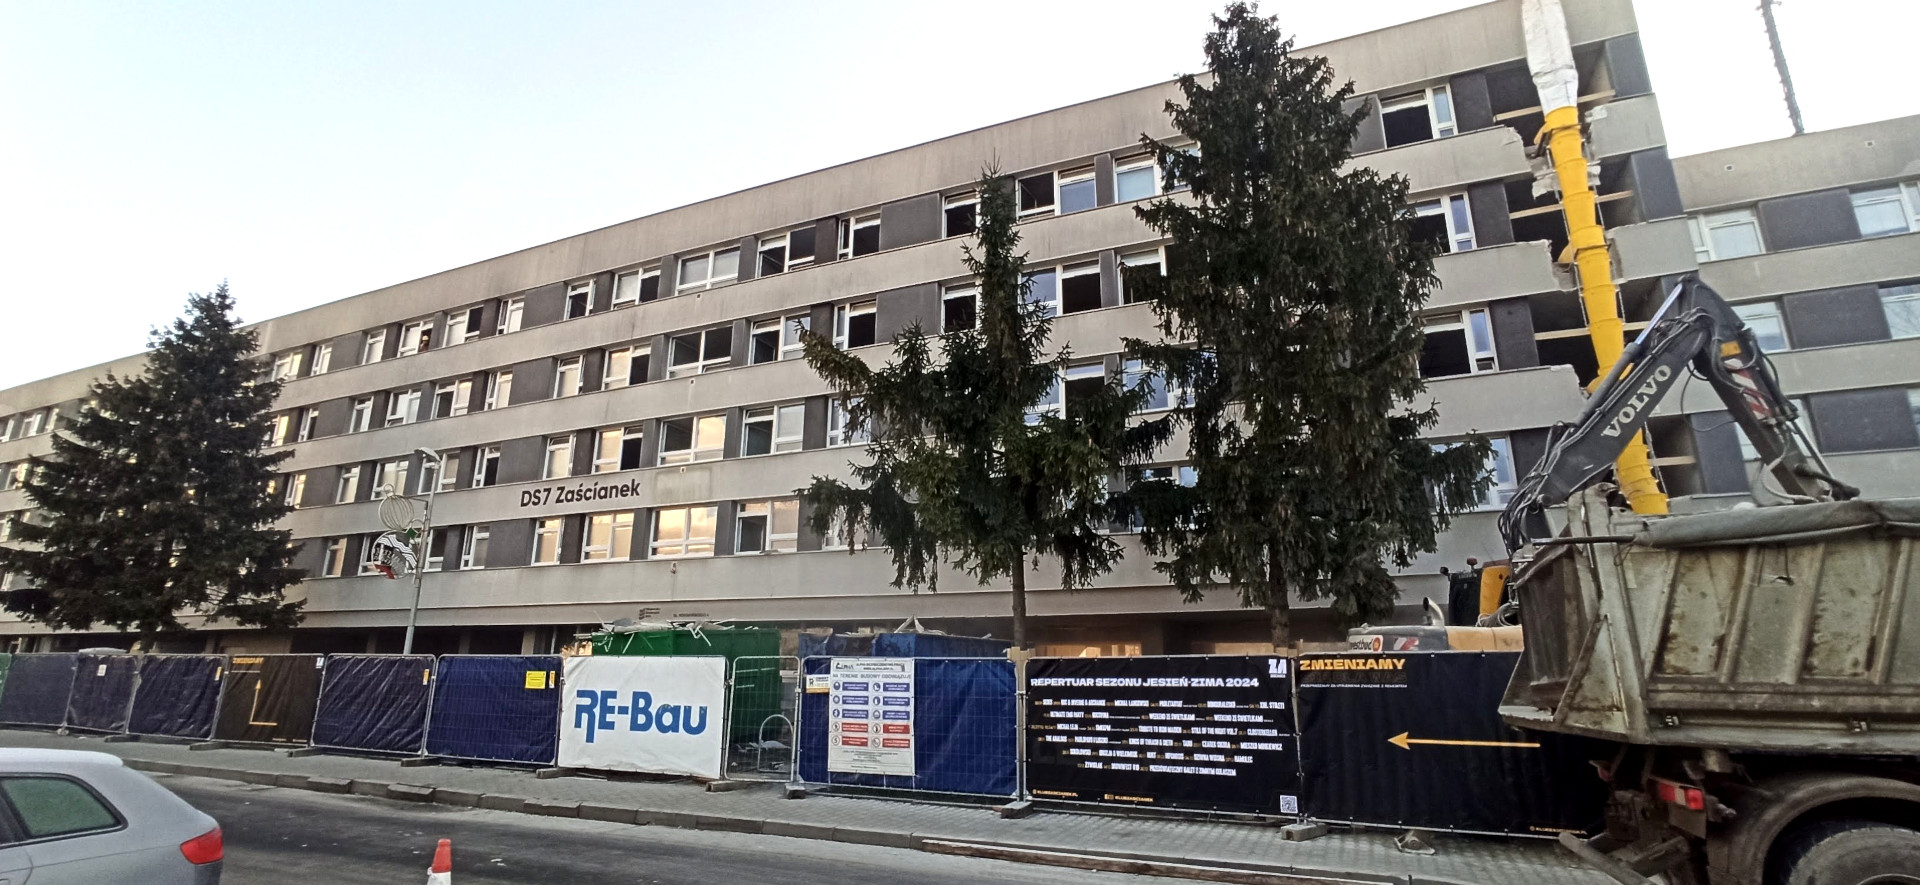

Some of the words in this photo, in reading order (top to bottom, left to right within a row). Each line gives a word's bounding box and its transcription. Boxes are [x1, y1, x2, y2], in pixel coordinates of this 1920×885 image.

[1601, 364, 1671, 437] VOLVO
[520, 488, 552, 507] DS7
[555, 479, 640, 504] Zaścianek
[1350, 638, 1373, 651] estbud
[1299, 658, 1406, 671] ZMIENIAMY
[1030, 677, 1094, 687] REPERTUAR
[1095, 678, 1142, 687] SEZONU
[1142, 676, 1225, 688] JESIEŃ-ZIMA
[1225, 677, 1260, 687] 2024
[574, 689, 708, 743] RE-Bau
